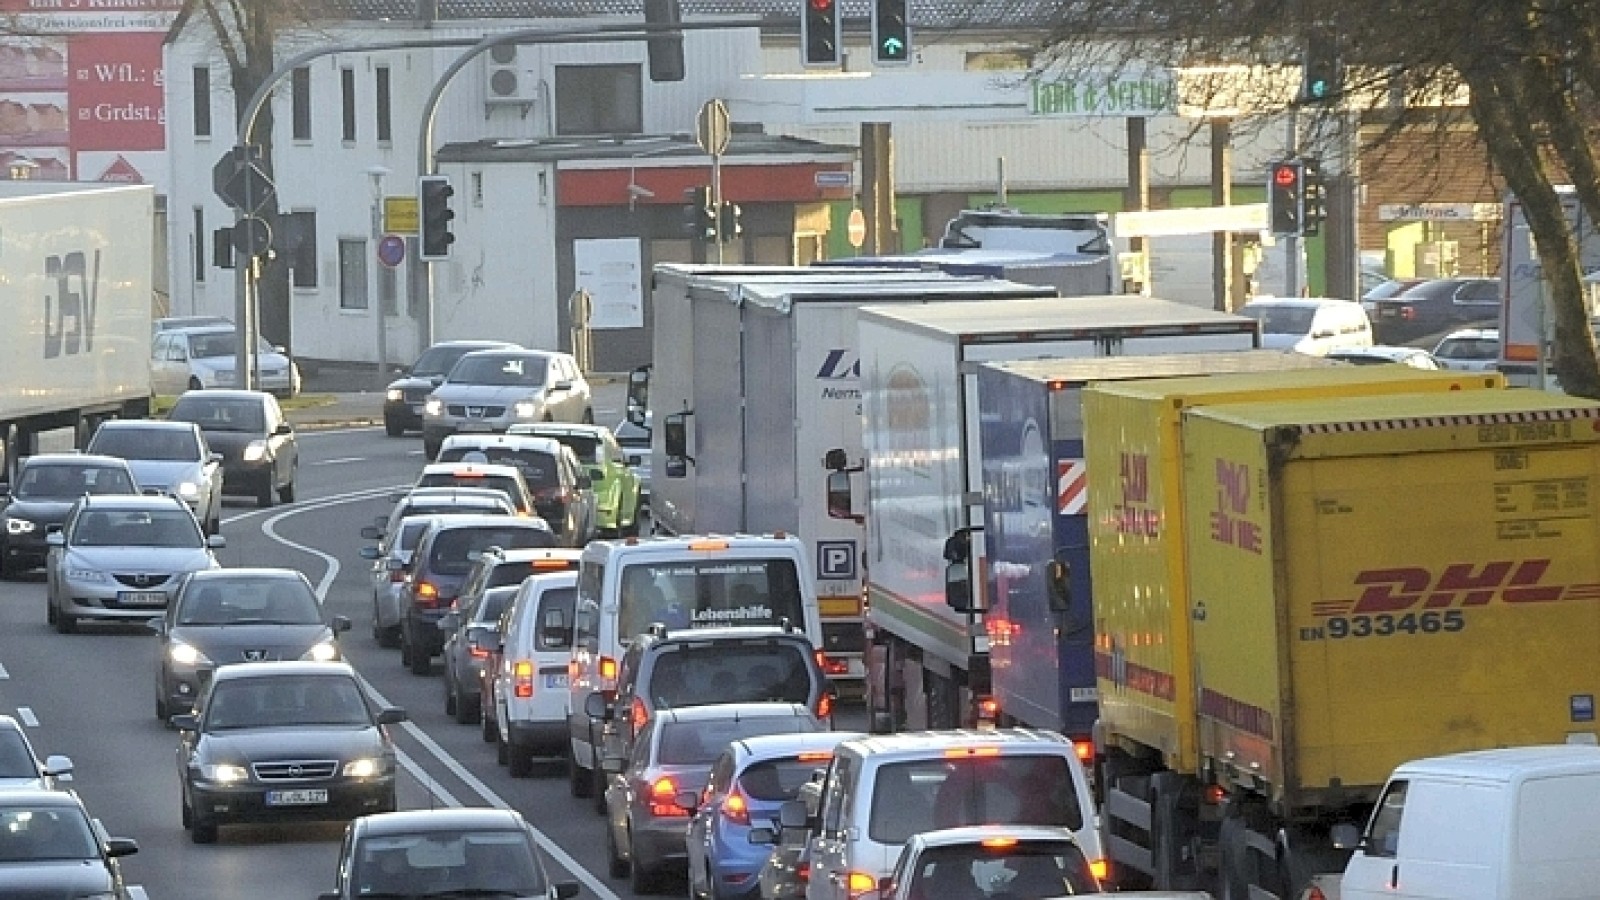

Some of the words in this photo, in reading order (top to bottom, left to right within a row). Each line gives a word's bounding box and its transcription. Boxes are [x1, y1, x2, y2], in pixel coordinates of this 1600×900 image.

[44, 248, 100, 360] DSV
[827, 549, 847, 572] P
[1351, 558, 1566, 614] DHL
[690, 603, 773, 622] Lebenshilfe
[1299, 625, 1325, 641] EN
[1326, 609, 1466, 640] 933465
